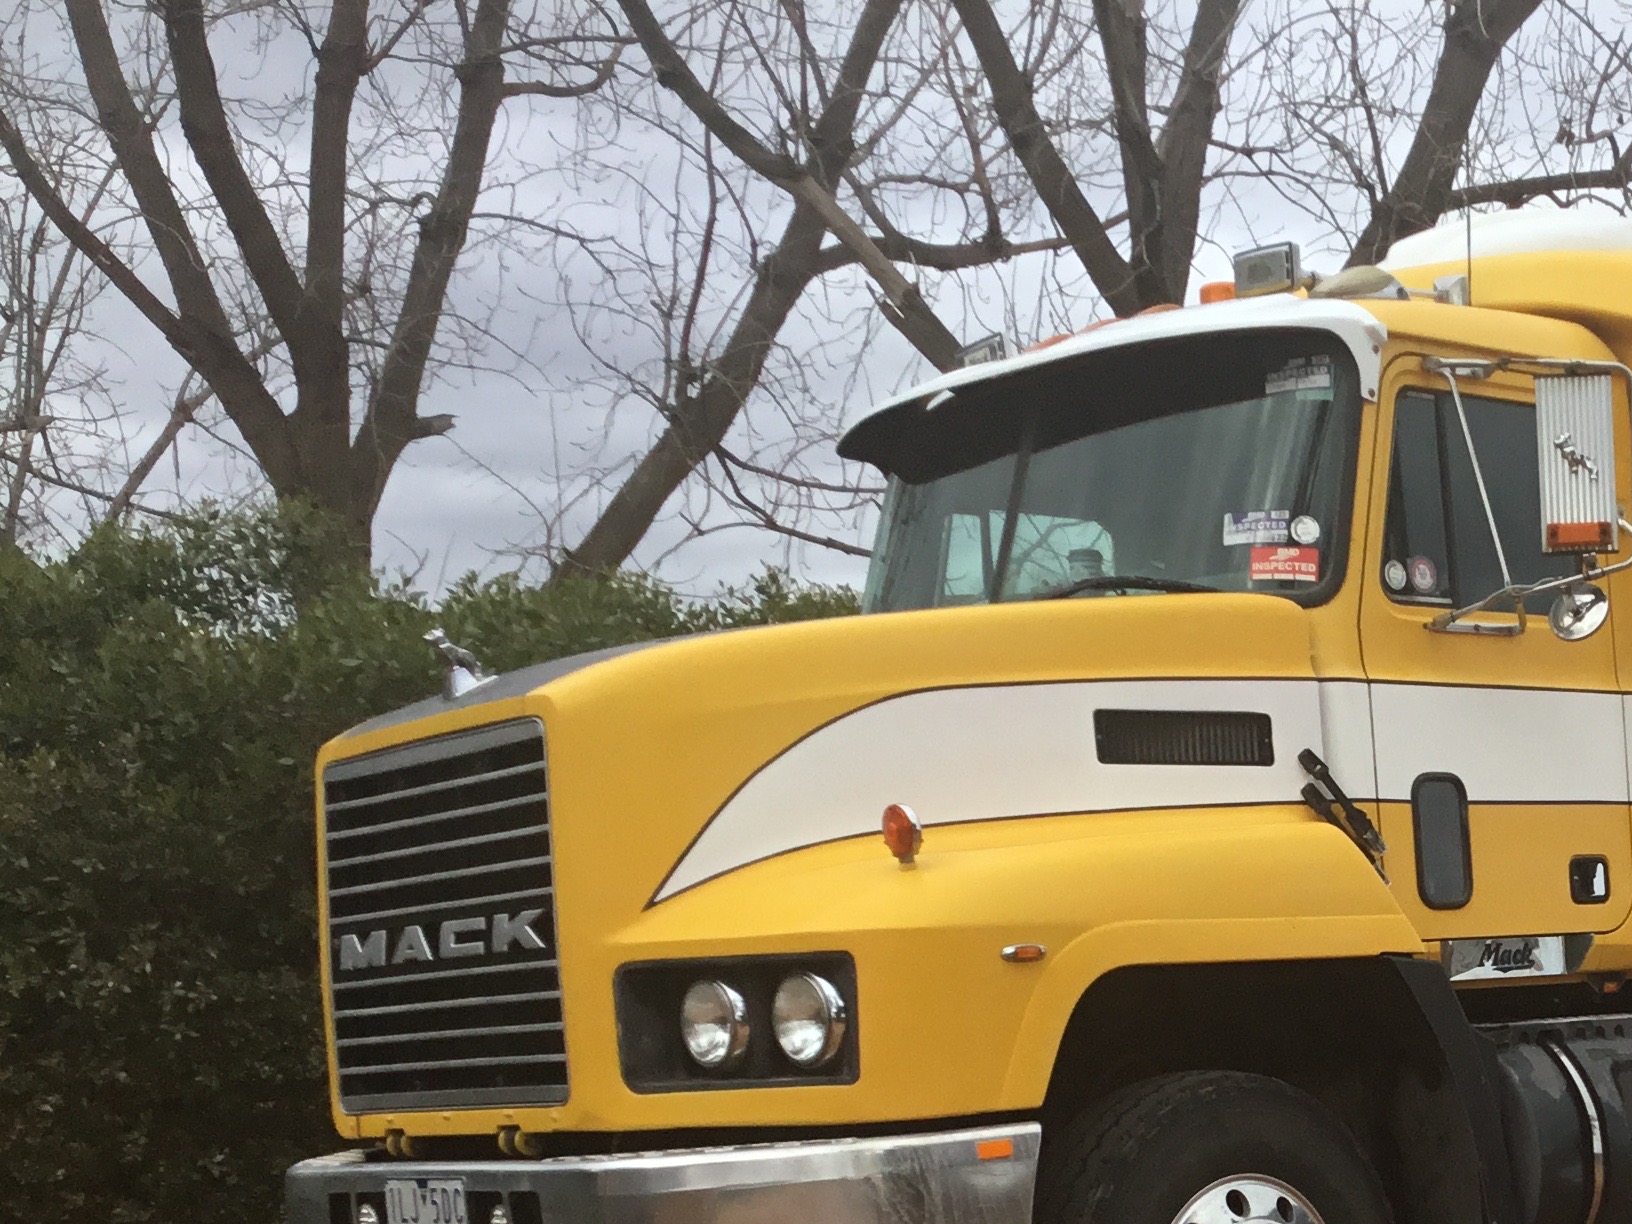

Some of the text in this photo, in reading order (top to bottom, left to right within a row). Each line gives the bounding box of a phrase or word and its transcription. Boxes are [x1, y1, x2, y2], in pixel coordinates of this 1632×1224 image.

[1252, 561, 1316, 572] INSPECTED
[340, 908, 546, 971] MACK
[1477, 941, 1536, 968] Mack
